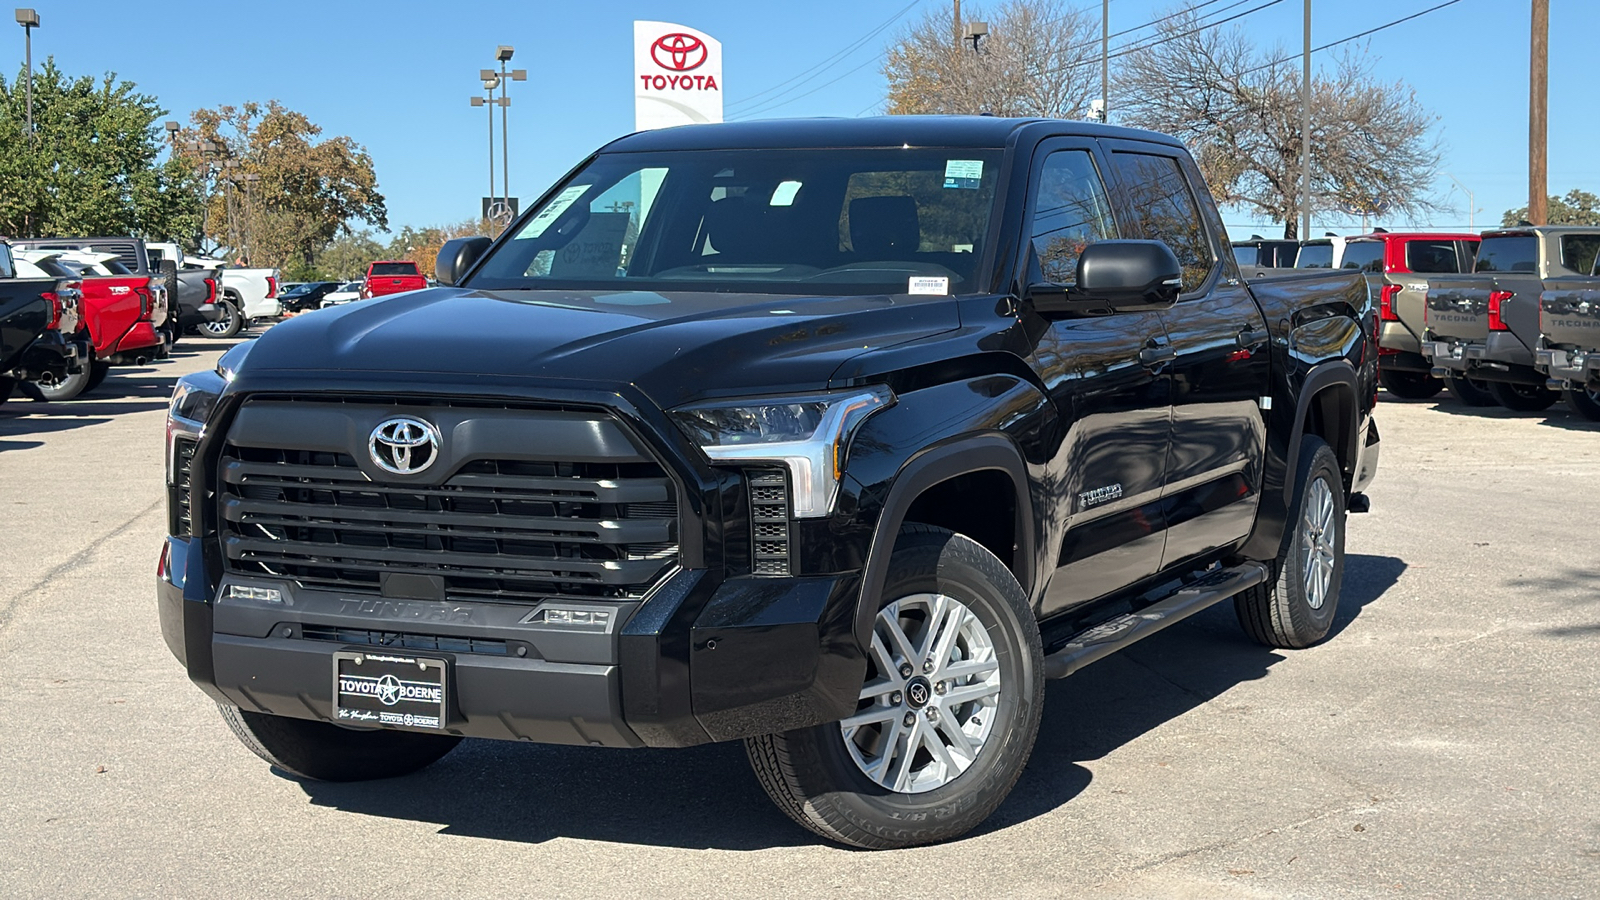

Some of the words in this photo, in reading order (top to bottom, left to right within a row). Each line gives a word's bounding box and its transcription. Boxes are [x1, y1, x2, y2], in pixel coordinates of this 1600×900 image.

[640, 75, 718, 91] TOYOTA
[1434, 314, 1477, 322] TACOMA
[1551, 319, 1600, 328] TACOMA
[1079, 483, 1122, 507] TUNDRA
[339, 598, 477, 625] TUNDRA
[340, 680, 383, 695] TOYOTA
[400, 687, 442, 699] BOERNE
[380, 714, 404, 723] TOYOTA
